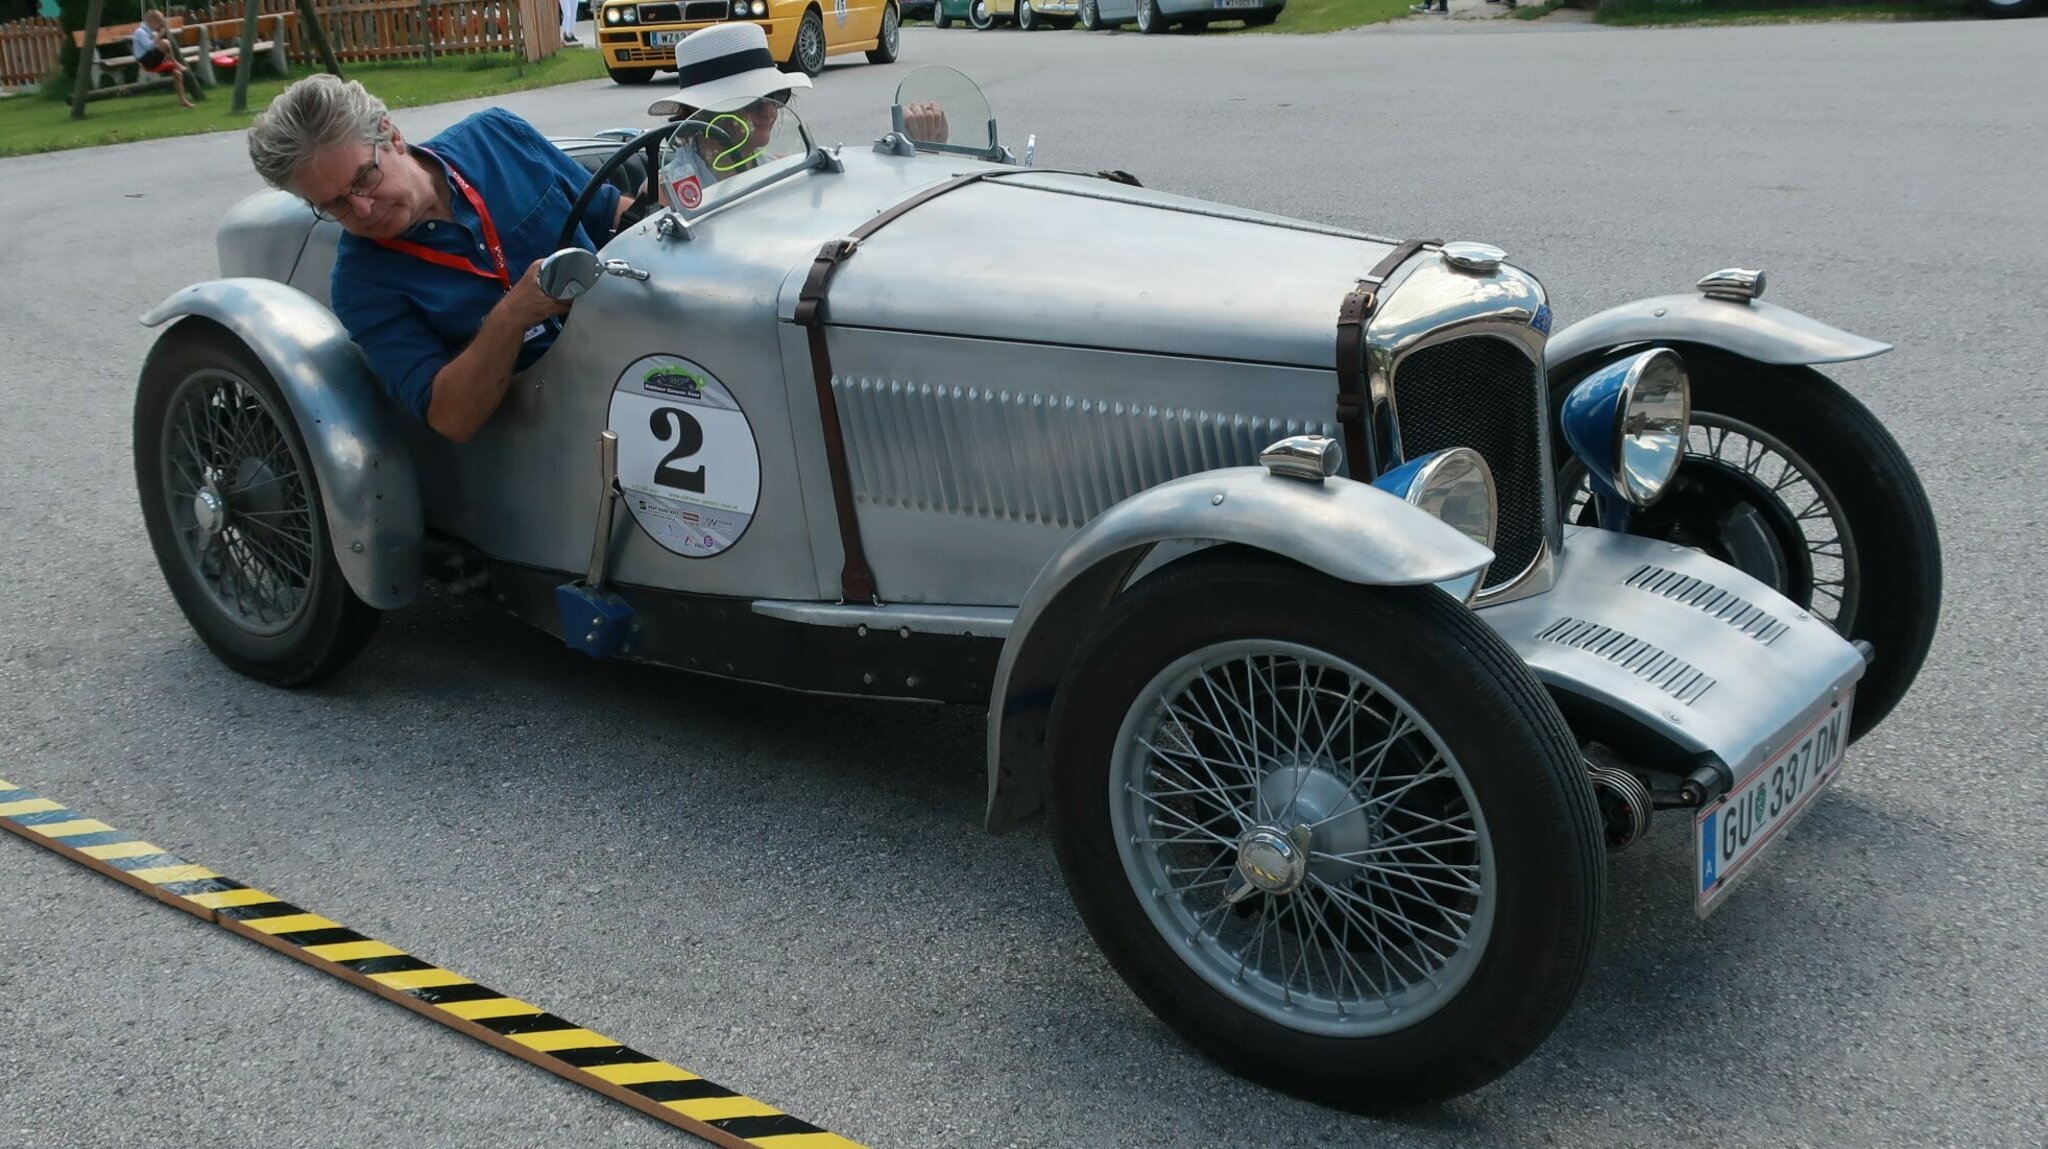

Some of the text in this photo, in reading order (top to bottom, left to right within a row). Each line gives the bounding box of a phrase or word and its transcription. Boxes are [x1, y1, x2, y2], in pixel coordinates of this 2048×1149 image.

[661, 33, 673, 43] WZ
[649, 406, 706, 494] 2
[1722, 709, 1843, 862] GU 337 DN
[1705, 861, 1713, 877] A
